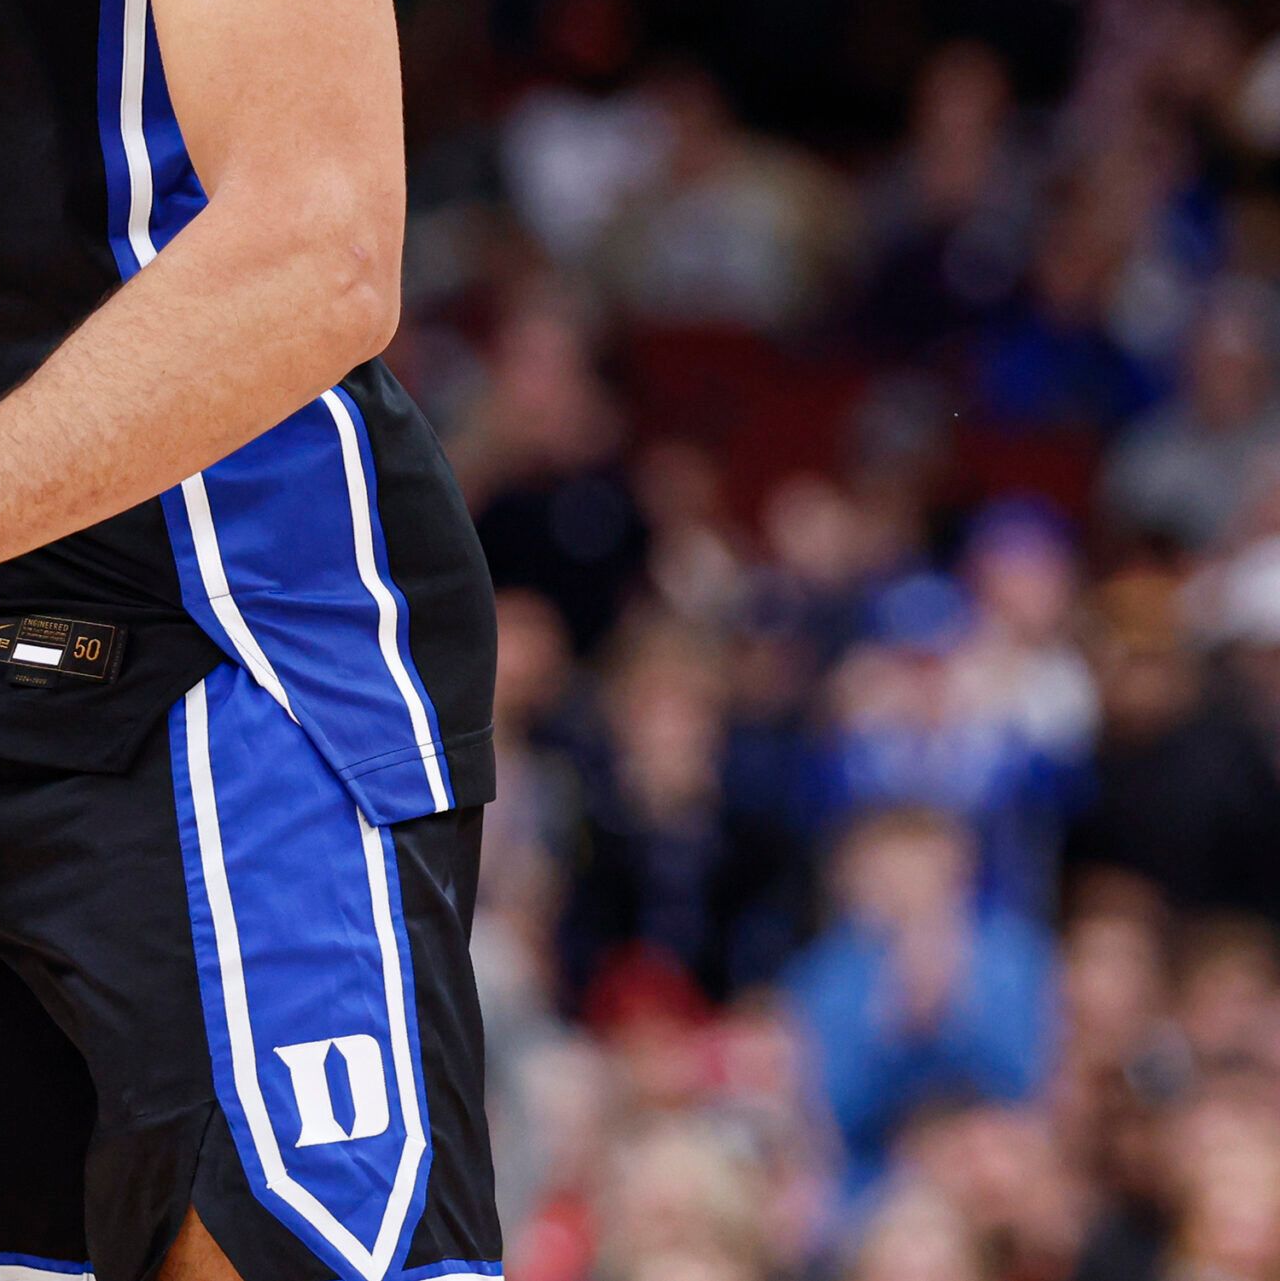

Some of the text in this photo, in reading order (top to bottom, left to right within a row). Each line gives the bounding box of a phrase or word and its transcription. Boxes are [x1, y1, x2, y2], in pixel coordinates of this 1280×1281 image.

[23, 618, 70, 633] ENGINEERED
[73, 636, 102, 661] 50
[273, 1034, 390, 1148] D
